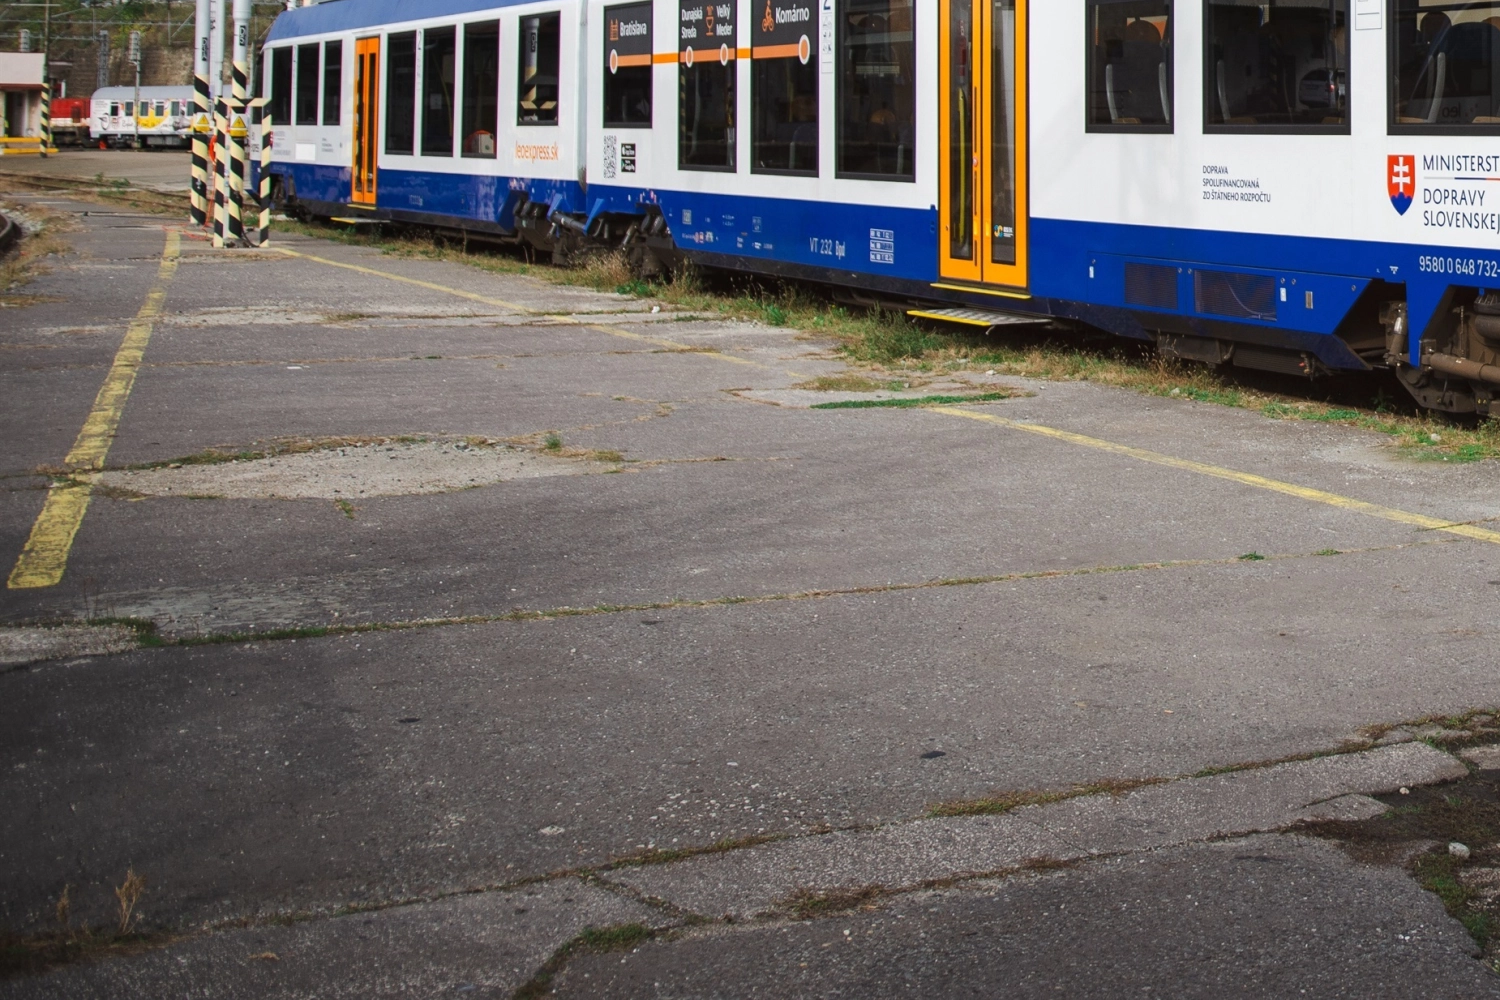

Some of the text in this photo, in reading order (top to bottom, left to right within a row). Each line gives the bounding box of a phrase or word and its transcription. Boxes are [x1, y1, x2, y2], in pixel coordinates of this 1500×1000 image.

[681, 6, 703, 23] Dunajská
[775, 5, 810, 24] Komárno
[620, 20, 647, 37] Bratislava
[681, 25, 697, 39] Streda
[716, 22, 733, 37] Meder
[515, 140, 559, 163] leoexpress.sk
[1202, 165, 1229, 174] DOPRAVA
[1202, 177, 1260, 188] SPOLUFINANCOVANÁ
[1202, 189, 1271, 203] ZO ŠTÁTNEHO ROZPOČTU
[1423, 188, 1486, 207] DOPRAVY
[1423, 210, 1500, 235] SLOVENSKEJ
[809, 237, 819, 253] VT
[820, 239, 832, 255] 232
[1419, 255, 1445, 273] 9580
[1446, 257, 1454, 274] 0
[1455, 258, 1475, 276] 648
